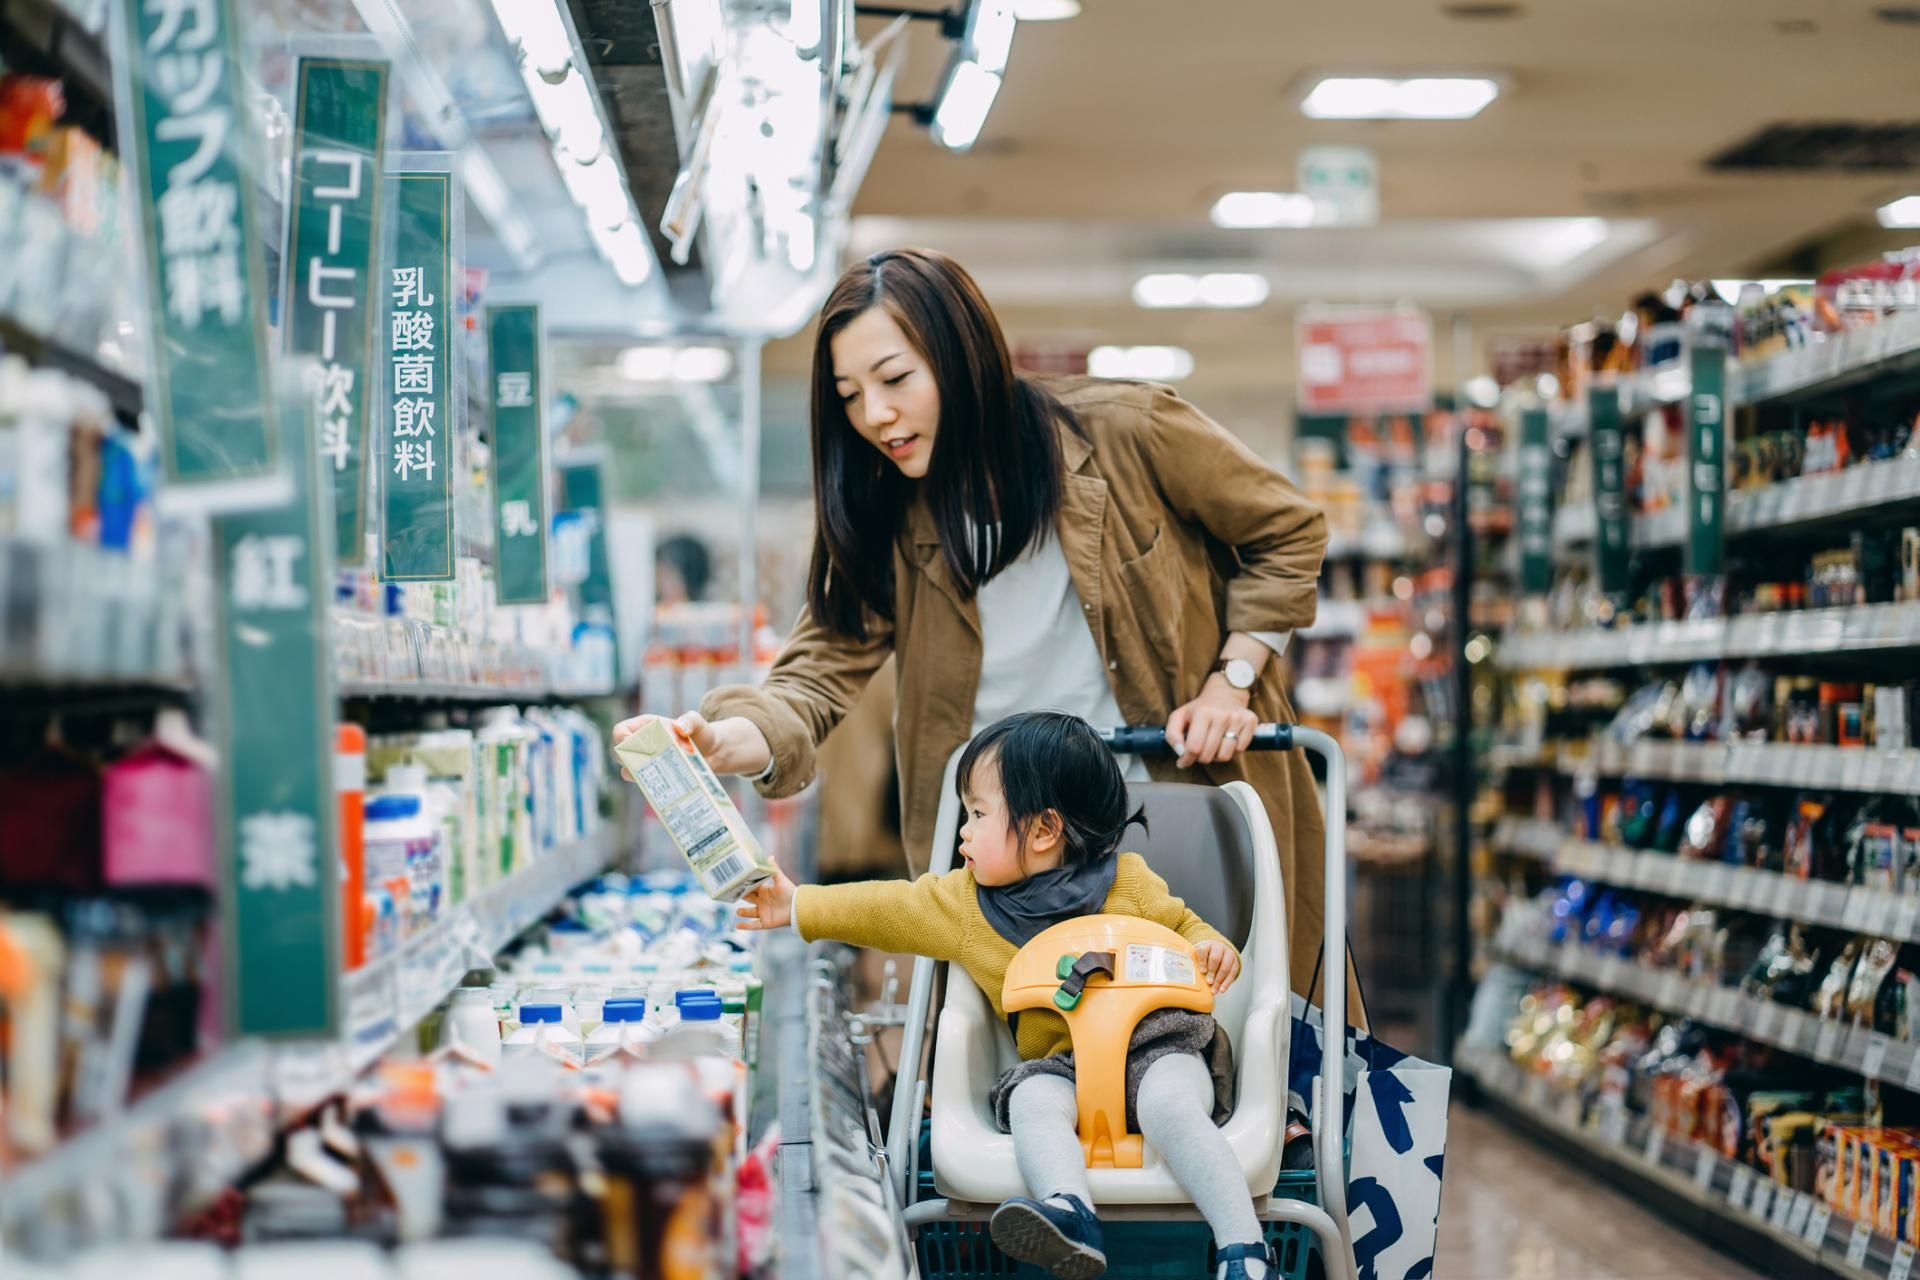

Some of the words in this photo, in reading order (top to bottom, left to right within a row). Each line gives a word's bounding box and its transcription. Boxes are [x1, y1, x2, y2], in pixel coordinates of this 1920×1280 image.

[391, 266, 436, 481] 乳酸菌飲料
[496, 371, 538, 537] 豆乳
